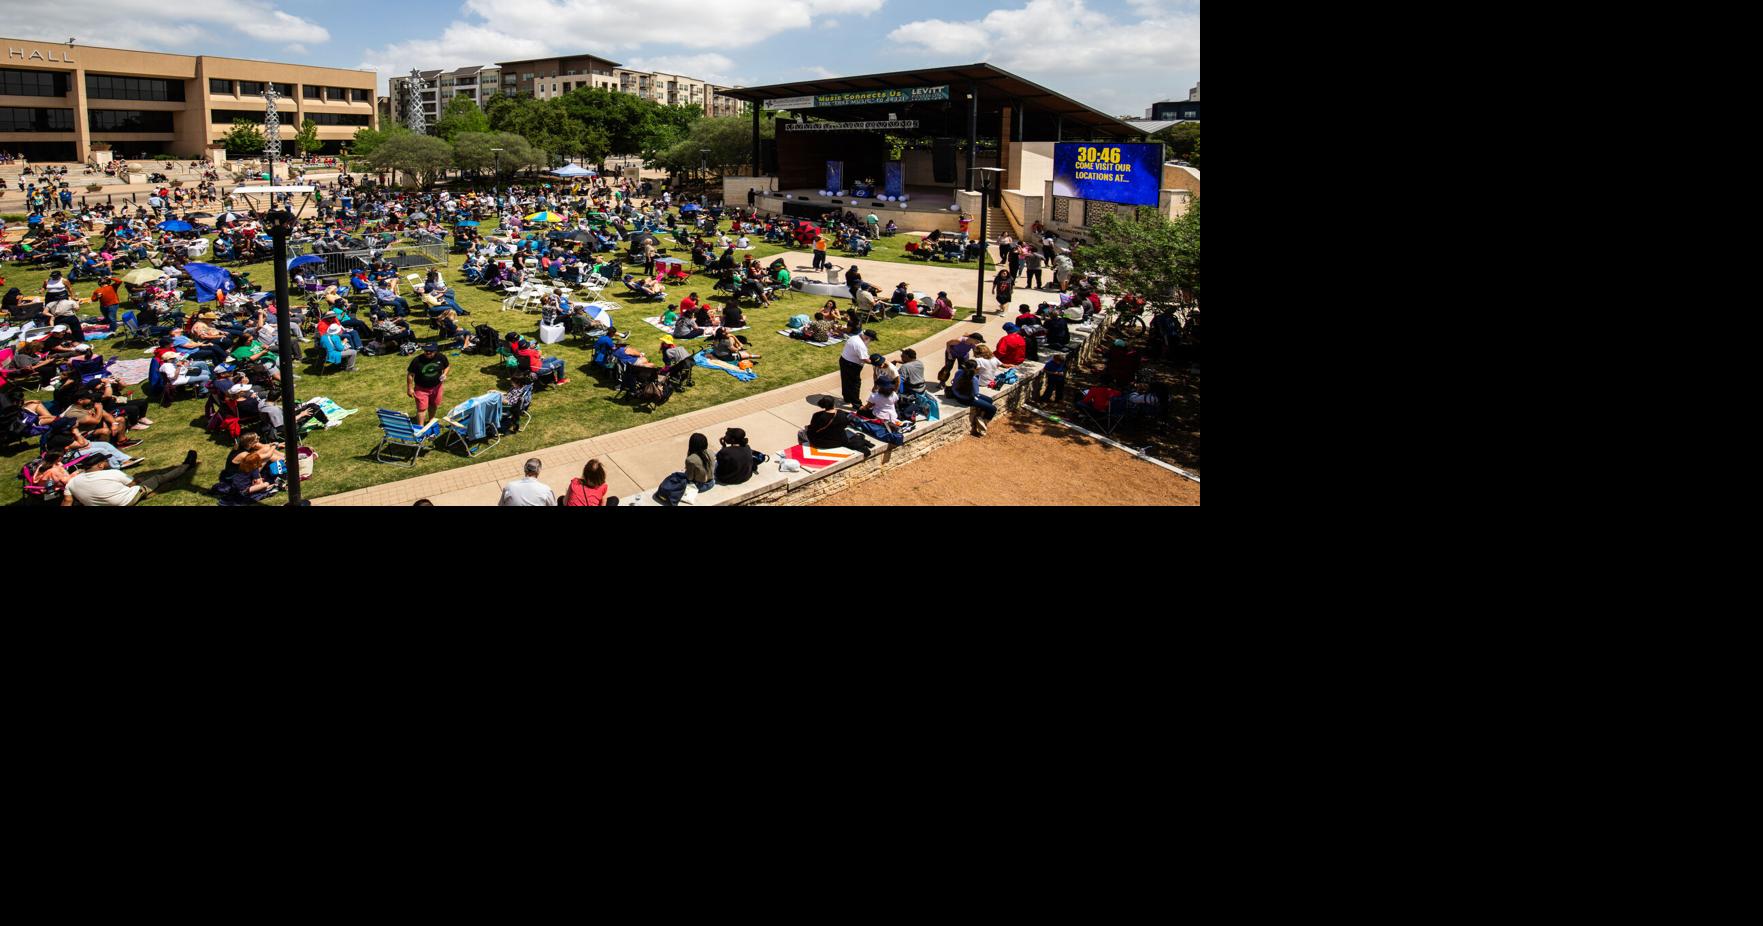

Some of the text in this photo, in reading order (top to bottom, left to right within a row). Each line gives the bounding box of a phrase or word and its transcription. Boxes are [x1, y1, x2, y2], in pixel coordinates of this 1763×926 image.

[9, 47, 75, 63] HALL
[844, 91, 886, 100] Connects
[1078, 147, 1121, 163] 30:46
[1075, 162, 1131, 172] COME VISIT OUR
[1075, 172, 1113, 182] LOCATIONS
